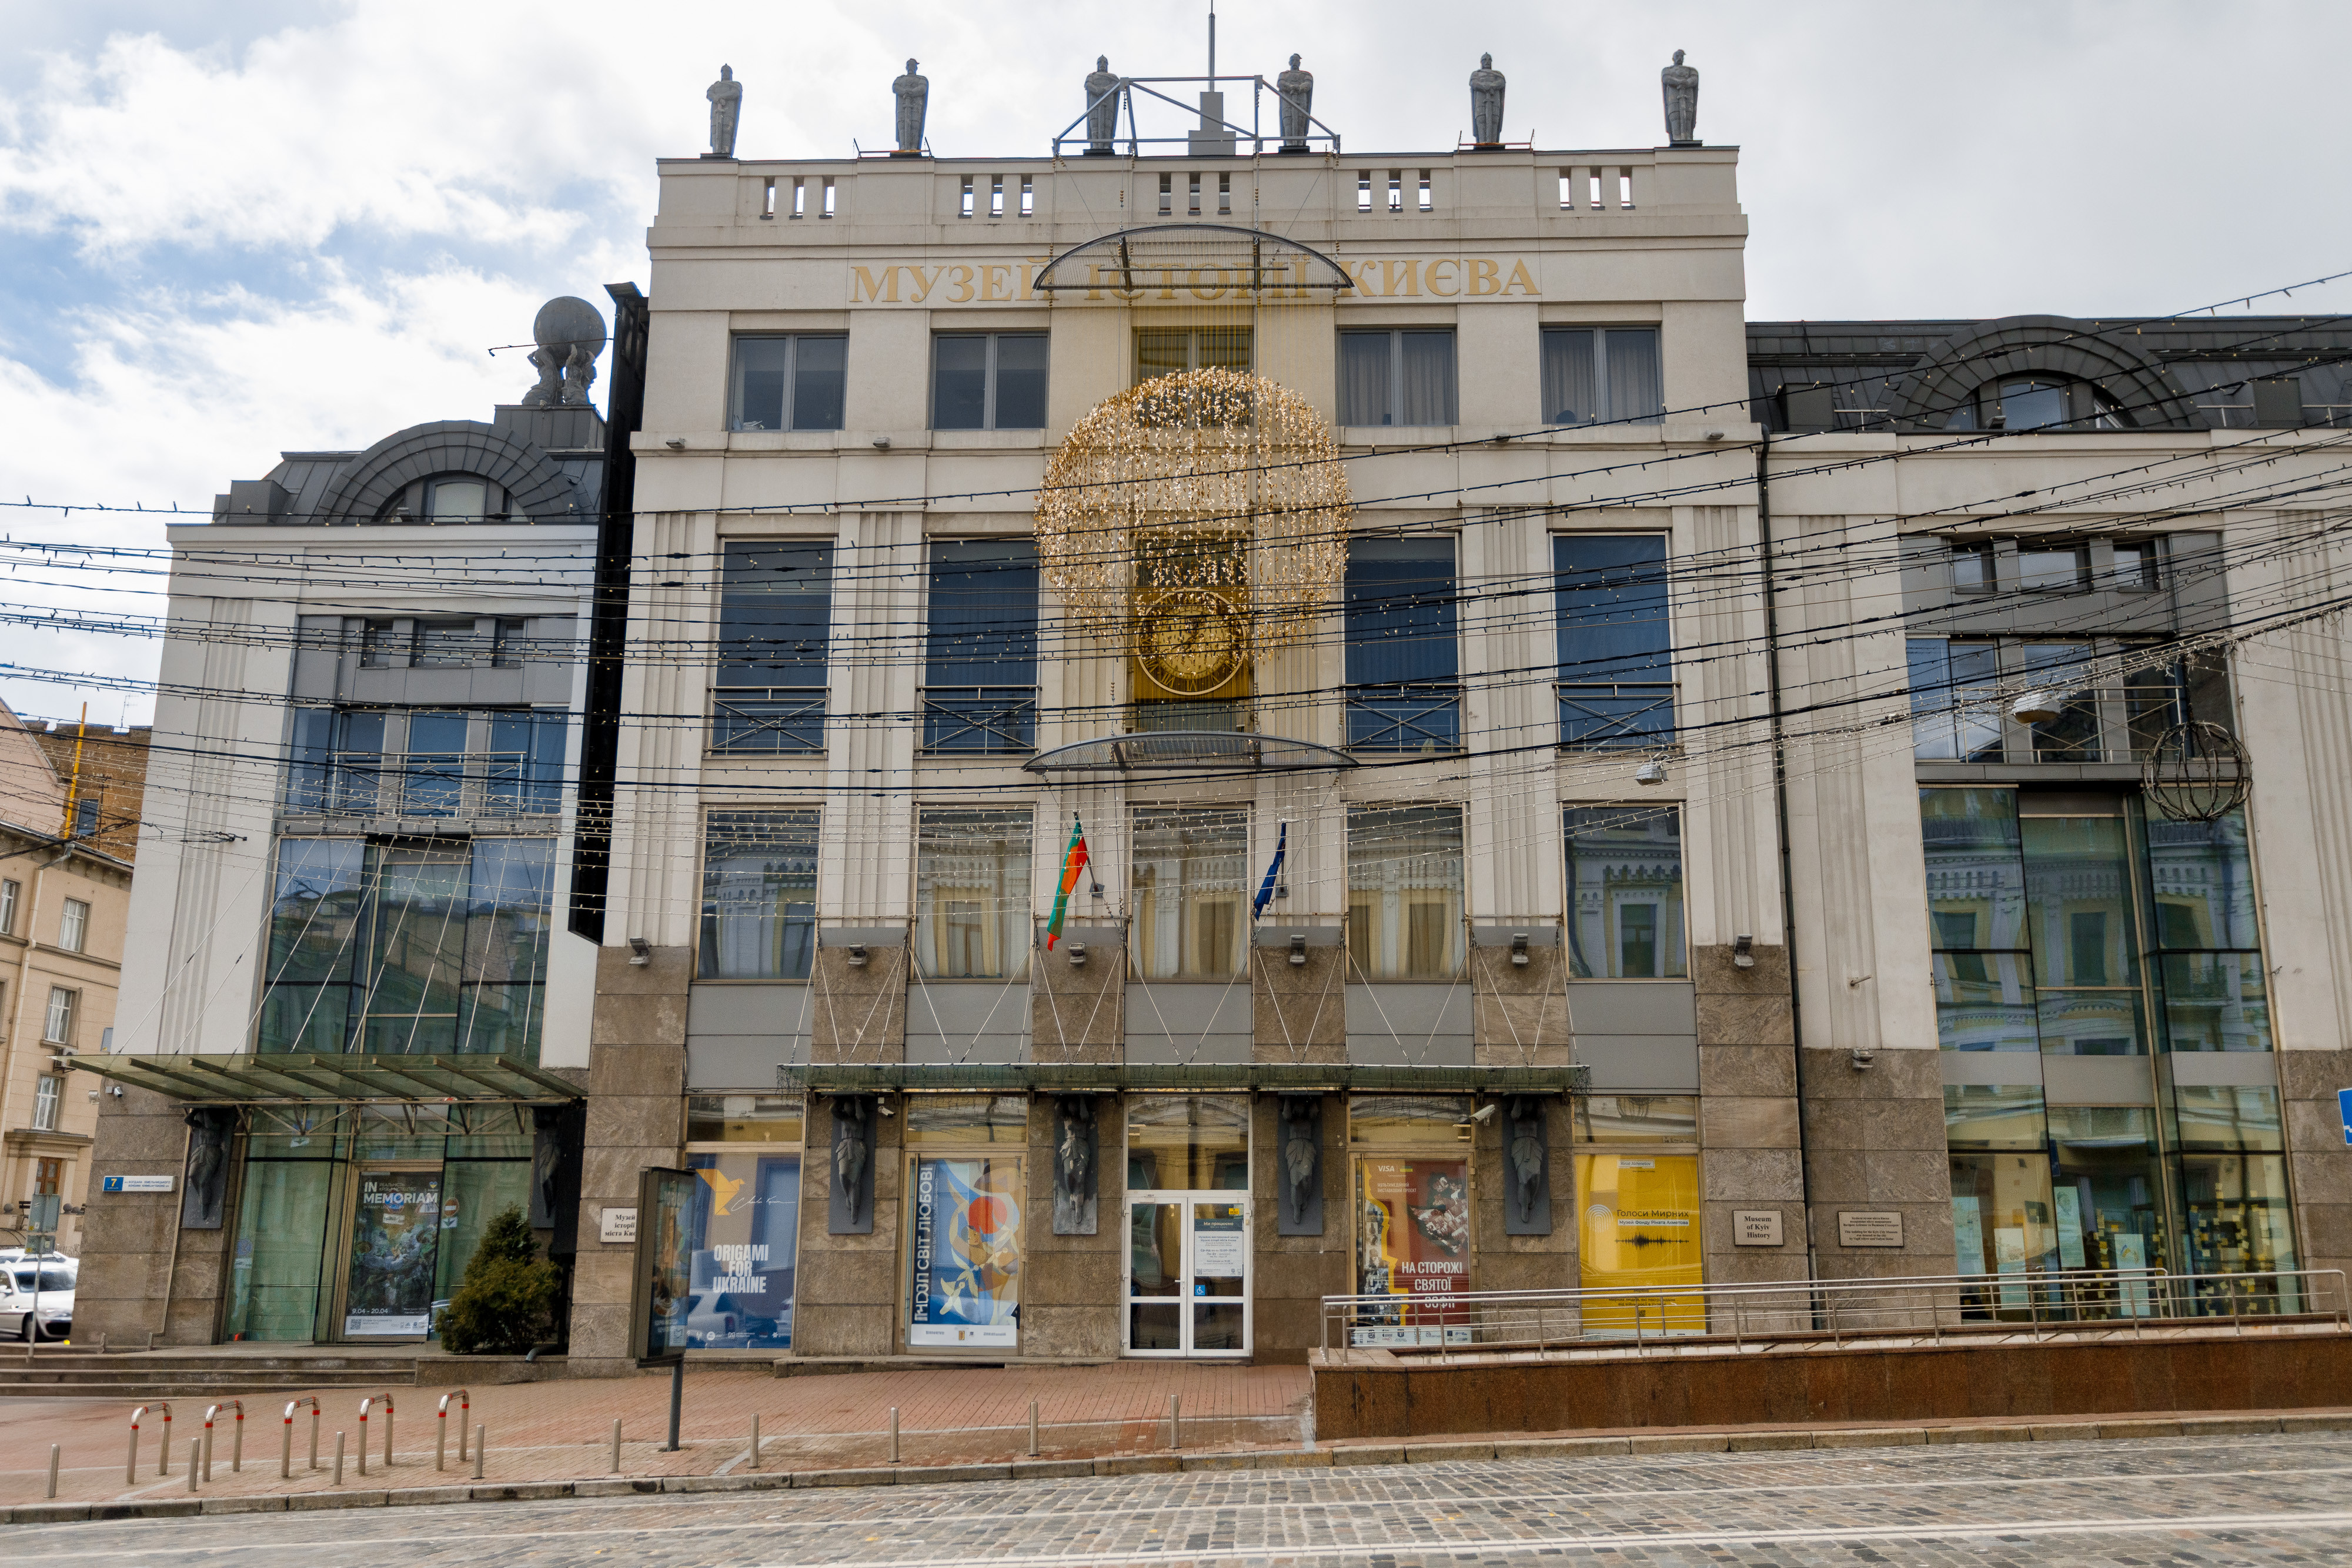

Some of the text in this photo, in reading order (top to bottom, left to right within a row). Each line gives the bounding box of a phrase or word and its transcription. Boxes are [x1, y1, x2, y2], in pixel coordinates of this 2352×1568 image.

[849, 254, 1542, 303] МУЗЕЙ ІСТОРІЇ КИЄВА
[111, 1178, 117, 1187] 7
[365, 1182, 377, 1192] IN
[363, 1192, 438, 1203] MEMORIAM
[918, 1167, 933, 1232] ЛЮБОВІ
[1651, 1210, 1689, 1218] Мирних
[714, 1244, 769, 1261] ORIGAMI
[917, 1235, 930, 1270] СВІТ
[728, 1261, 753, 1277] FOR
[1402, 1262, 1462, 1273] НА СТОРОЖІ
[713, 1276, 767, 1293] UKRAINE
[1415, 1276, 1452, 1290] СВЯТОЇ
